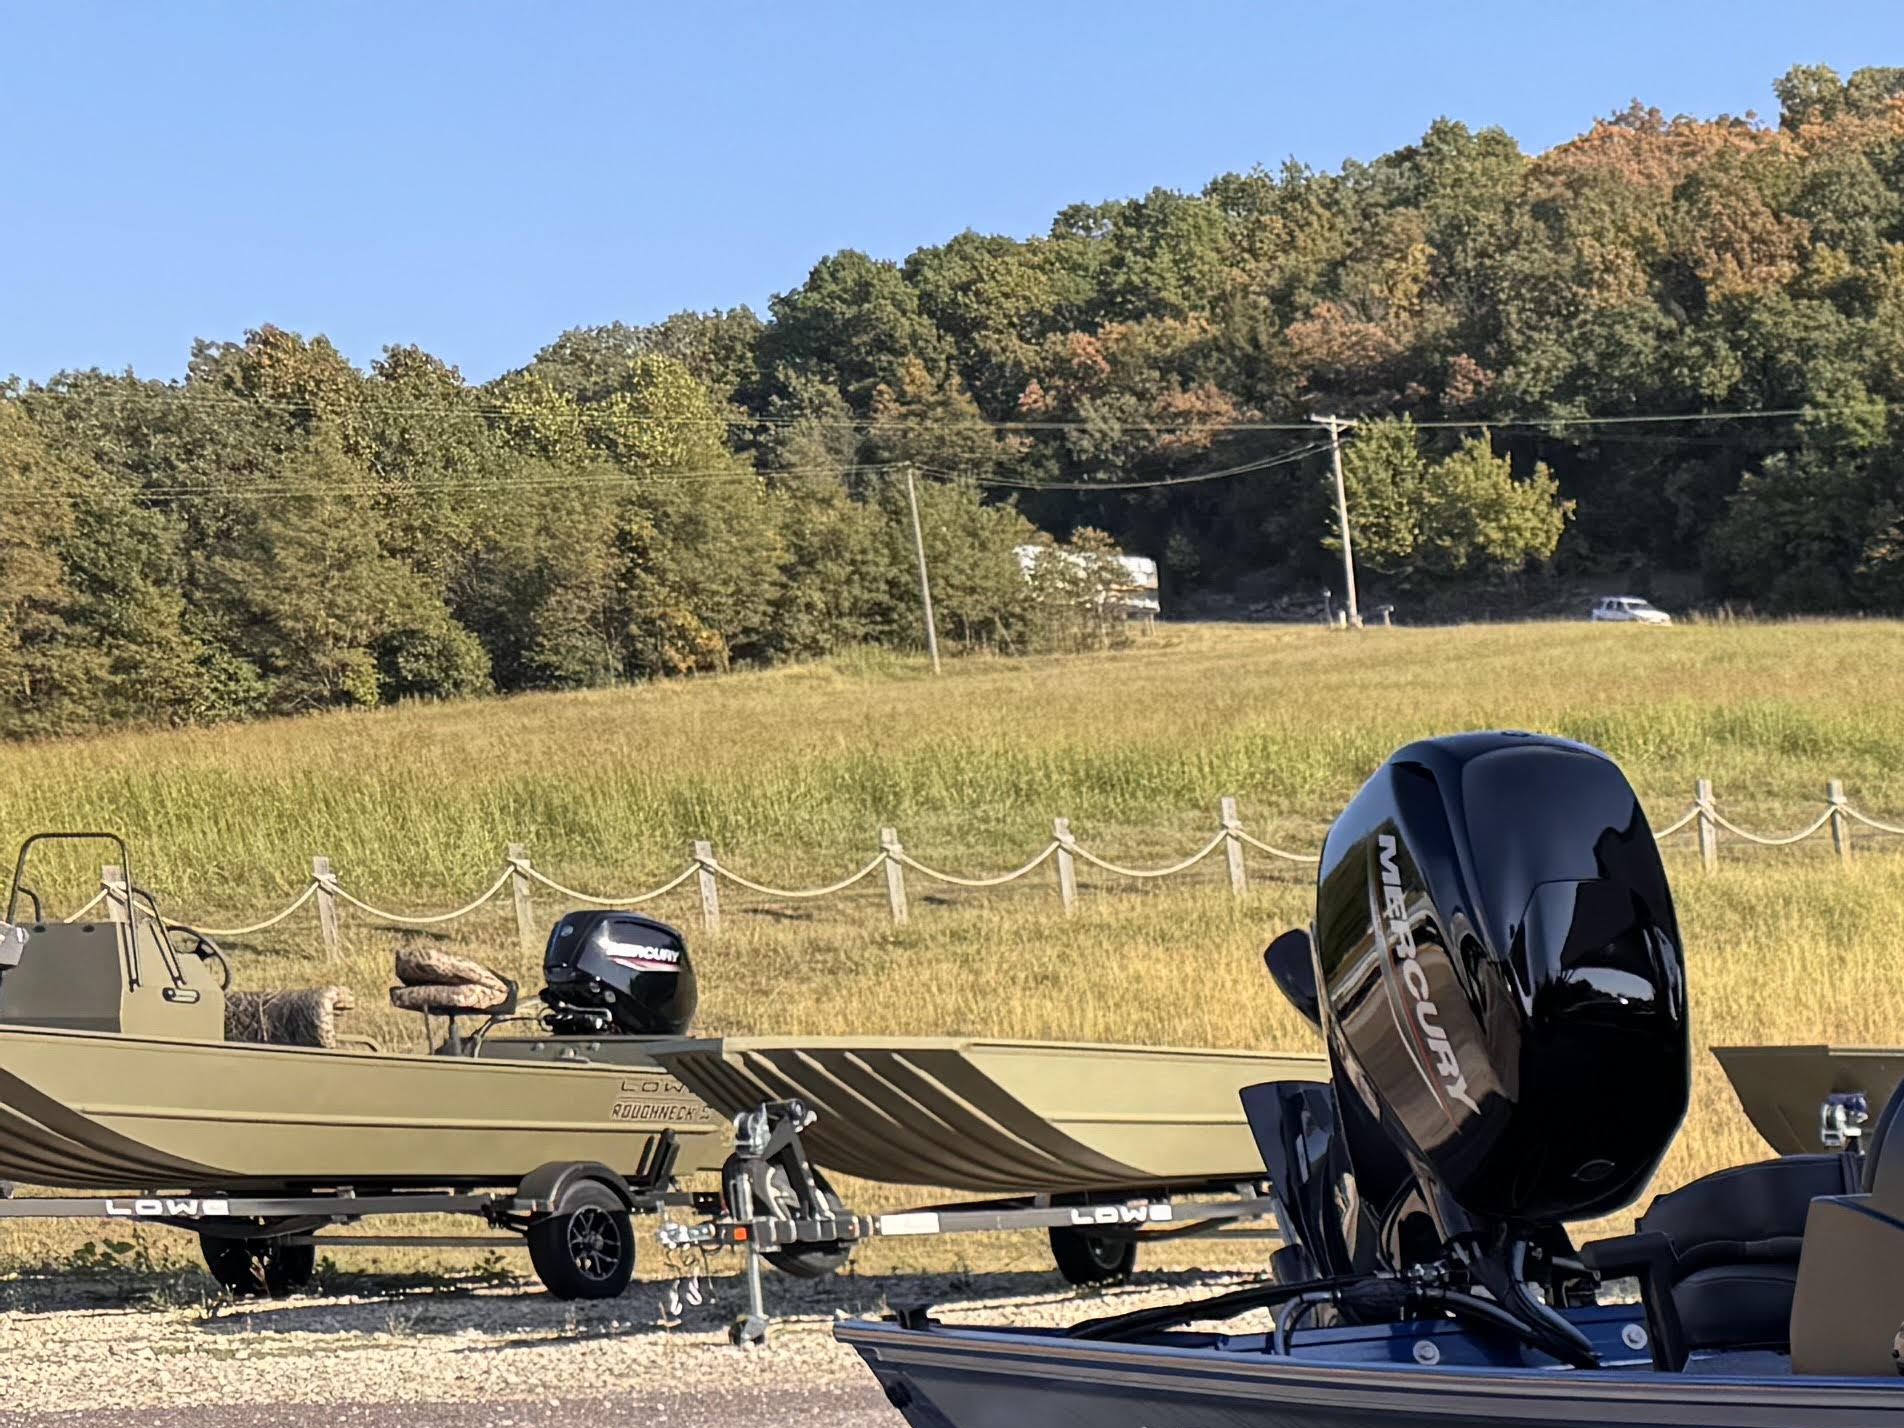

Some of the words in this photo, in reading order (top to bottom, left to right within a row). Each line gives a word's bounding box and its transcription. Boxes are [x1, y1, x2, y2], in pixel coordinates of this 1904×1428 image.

[606, 941, 680, 962] RCURY
[1377, 834, 1482, 1116] MERCURY
[621, 1080, 685, 1093] LOW
[611, 1103, 694, 1121] ROUGHNECK
